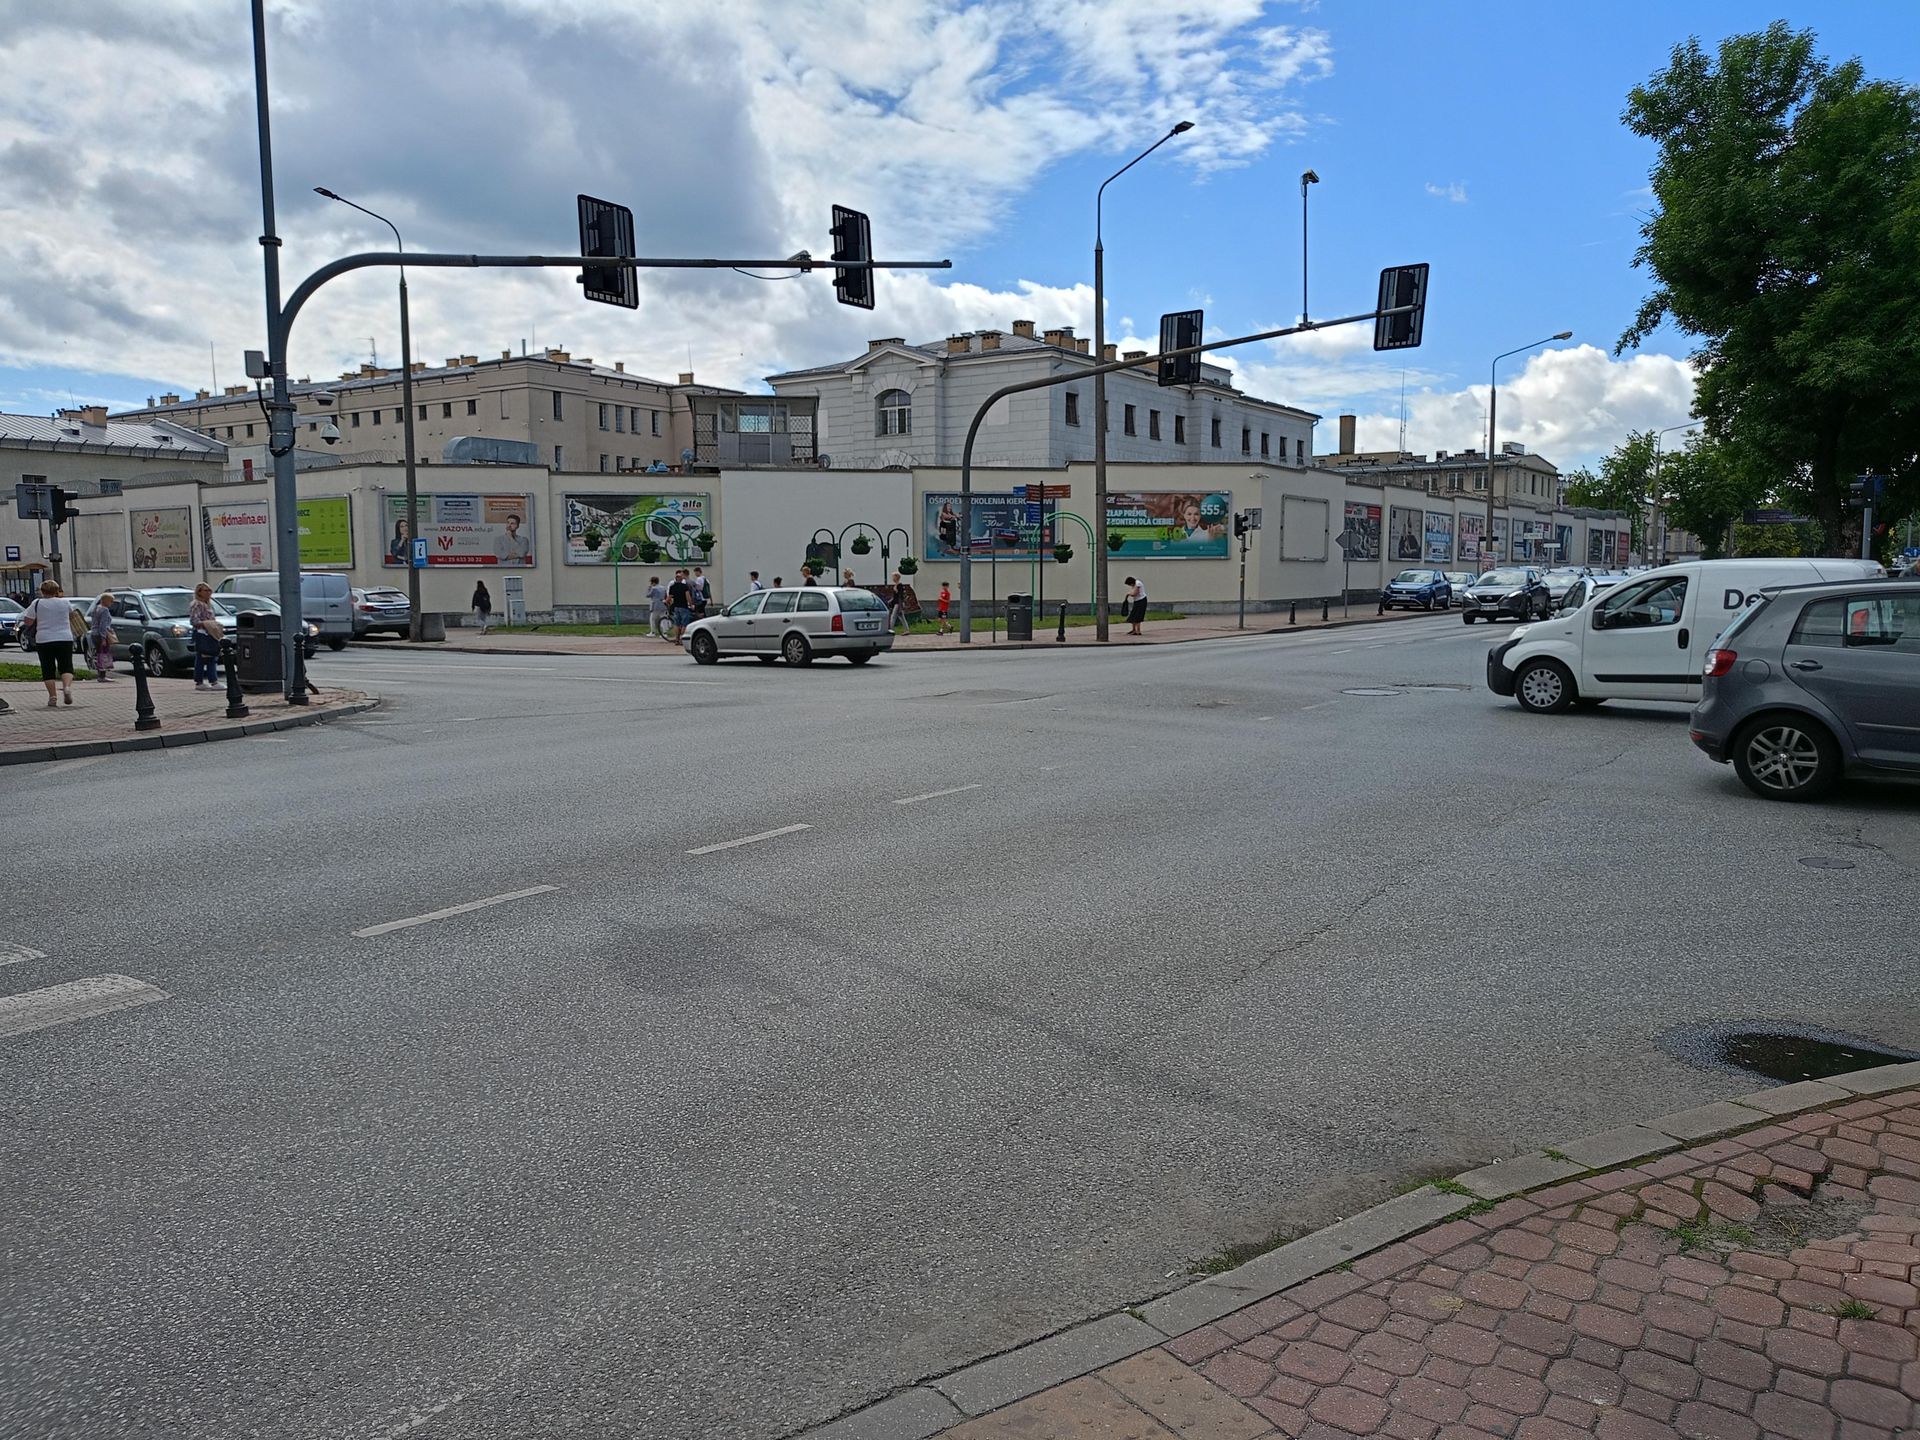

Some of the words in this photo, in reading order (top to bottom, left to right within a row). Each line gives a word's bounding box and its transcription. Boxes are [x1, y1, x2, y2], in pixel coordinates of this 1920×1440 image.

[682, 499, 702, 508] alfa
[970, 497, 1006, 505] ZKOLENIA
[1106, 509, 1123, 517] ZŁAP
[1200, 503, 1220, 515] 555
[1139, 517, 1152, 525] DLA
